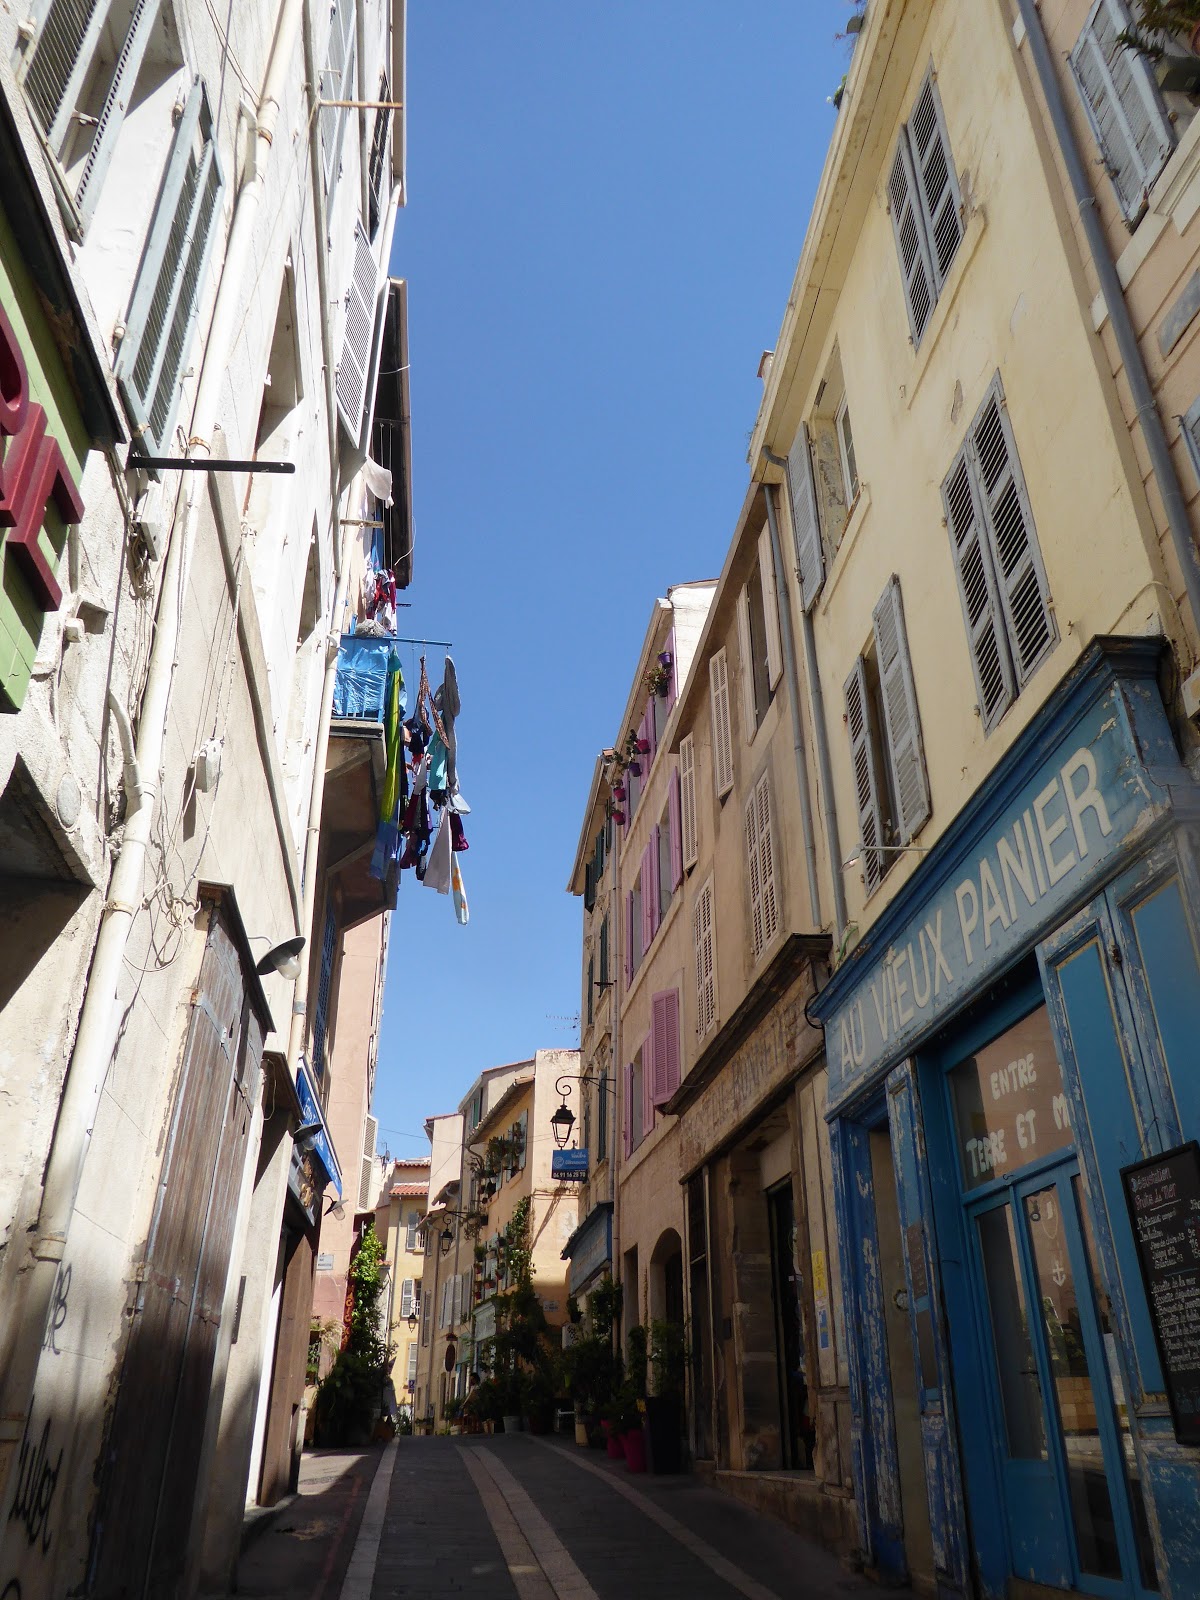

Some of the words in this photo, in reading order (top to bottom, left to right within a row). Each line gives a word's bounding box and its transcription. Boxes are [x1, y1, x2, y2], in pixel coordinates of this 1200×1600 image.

[840, 1006, 866, 1081] AU
[870, 911, 953, 1042] VIEUX
[956, 748, 1113, 965] PANIER
[990, 1052, 1037, 1101] ENTRE
[966, 1128, 1008, 1178] TERRE
[1016, 1108, 1036, 1150] ET
